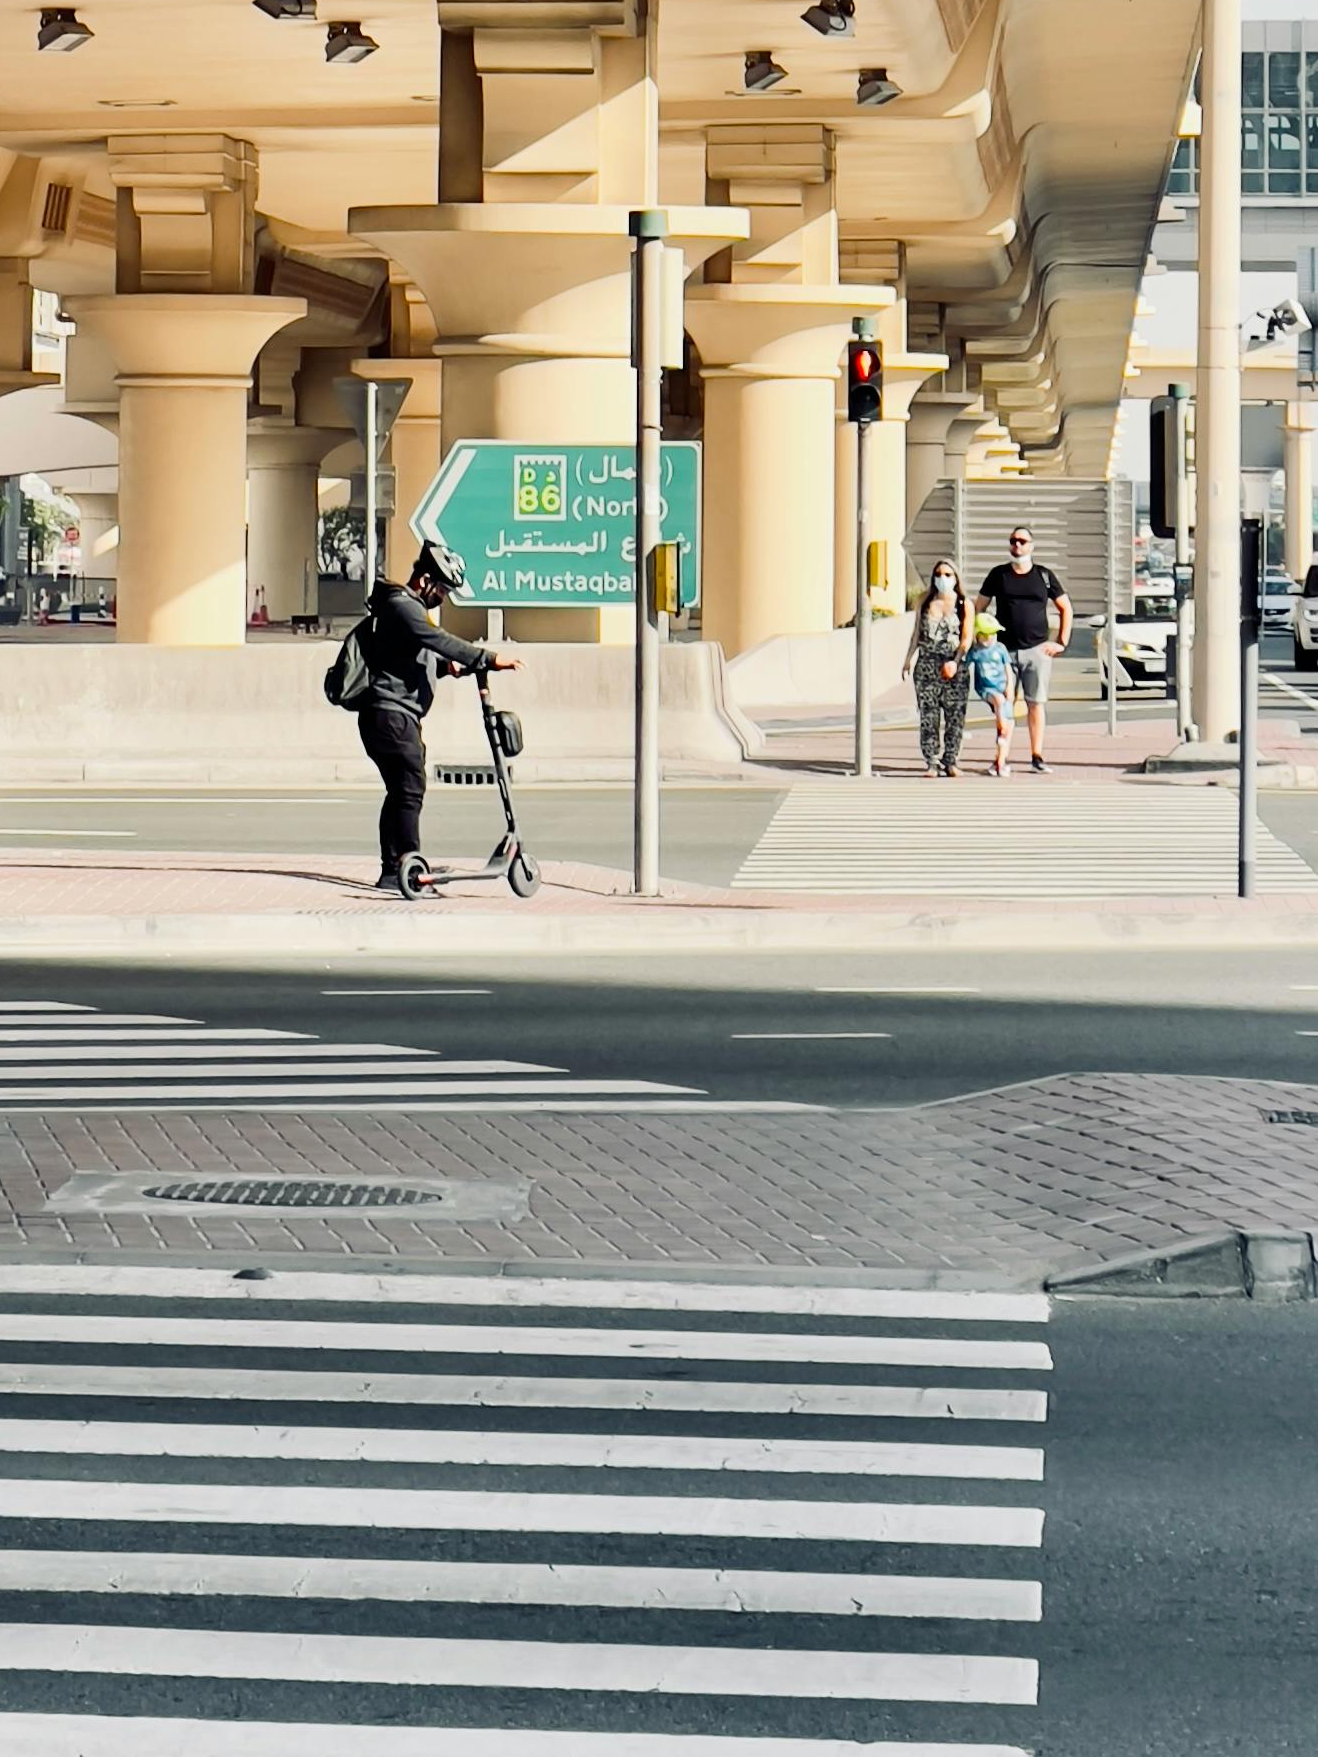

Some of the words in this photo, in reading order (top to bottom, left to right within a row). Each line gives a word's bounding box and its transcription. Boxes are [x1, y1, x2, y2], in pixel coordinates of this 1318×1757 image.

[523, 467, 537, 483] D
[519, 484, 561, 513] 86
[485, 529, 607, 559] المستقبل
[482, 570, 508, 591] Al
